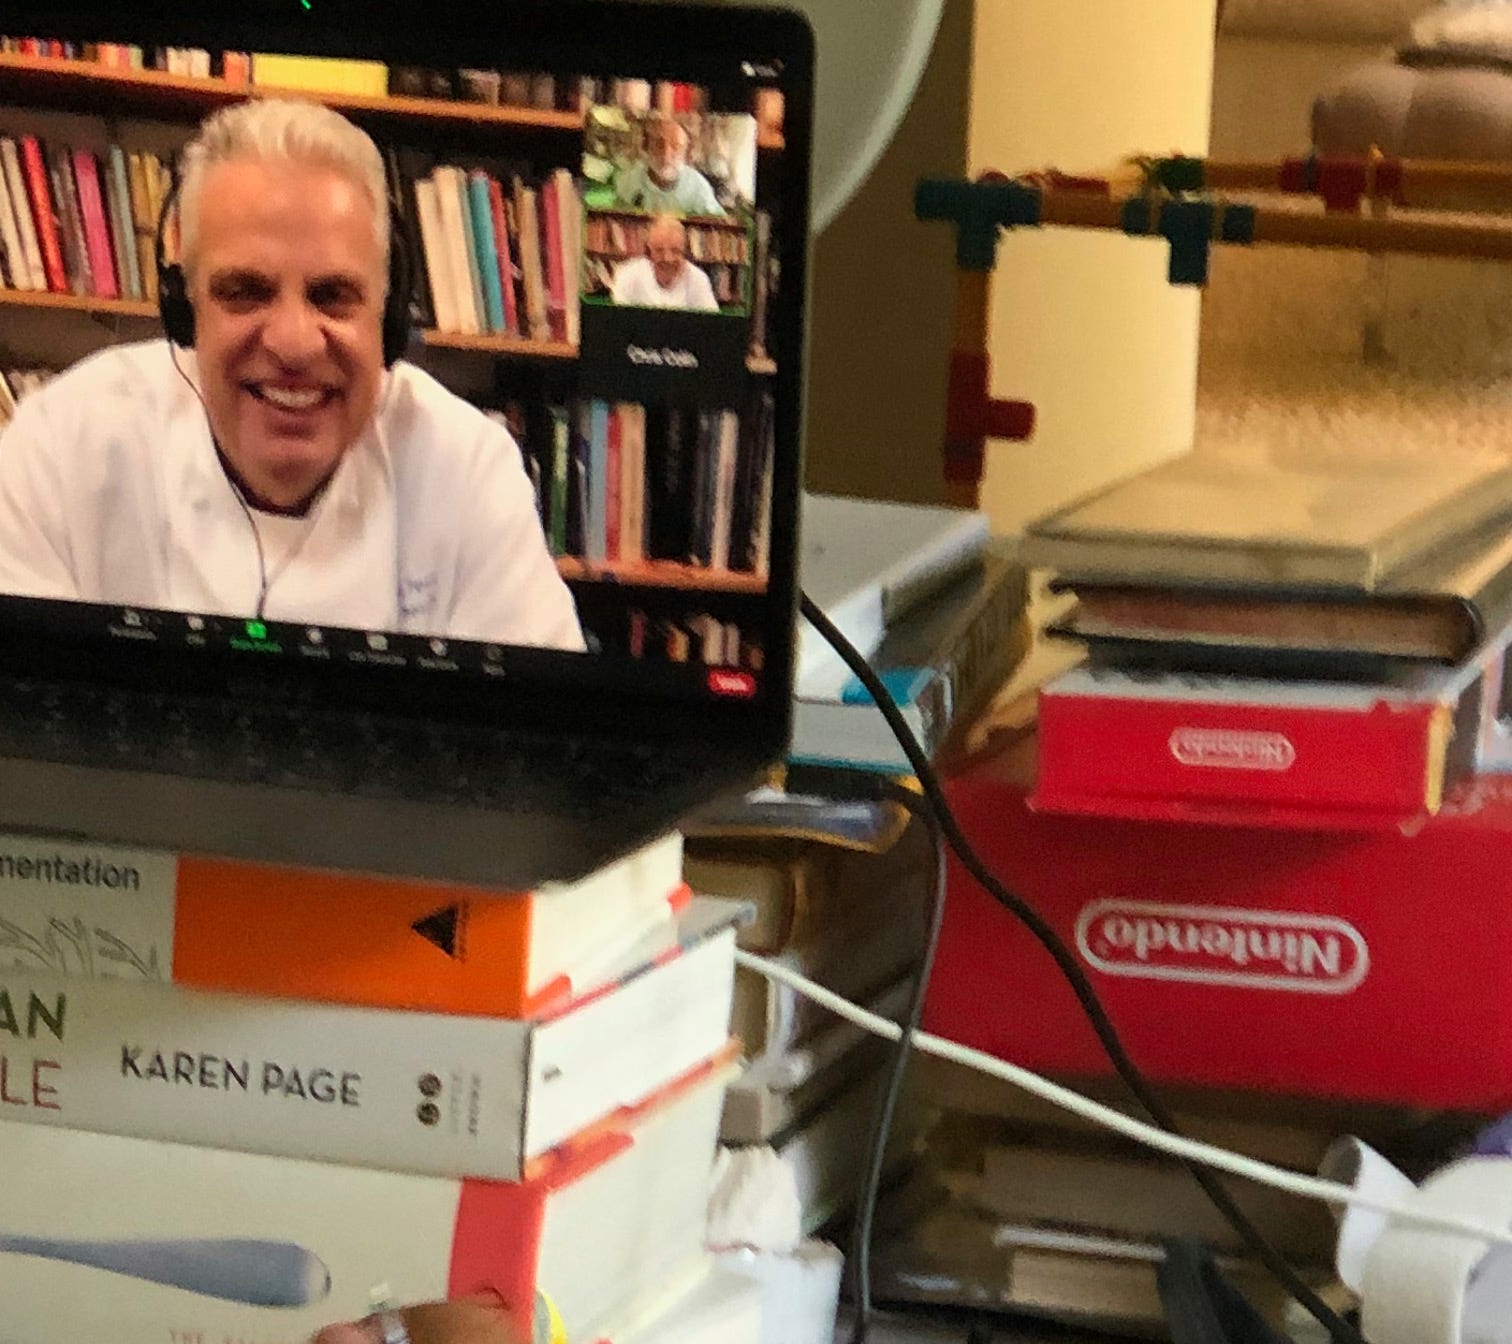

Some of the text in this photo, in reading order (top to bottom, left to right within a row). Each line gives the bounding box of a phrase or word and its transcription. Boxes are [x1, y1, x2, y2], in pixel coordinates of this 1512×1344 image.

[1182, 733, 1284, 764] Nintendo
[1102, 916, 1342, 977] Nintendo
[120, 1044, 363, 1107] KAREN PAGE
